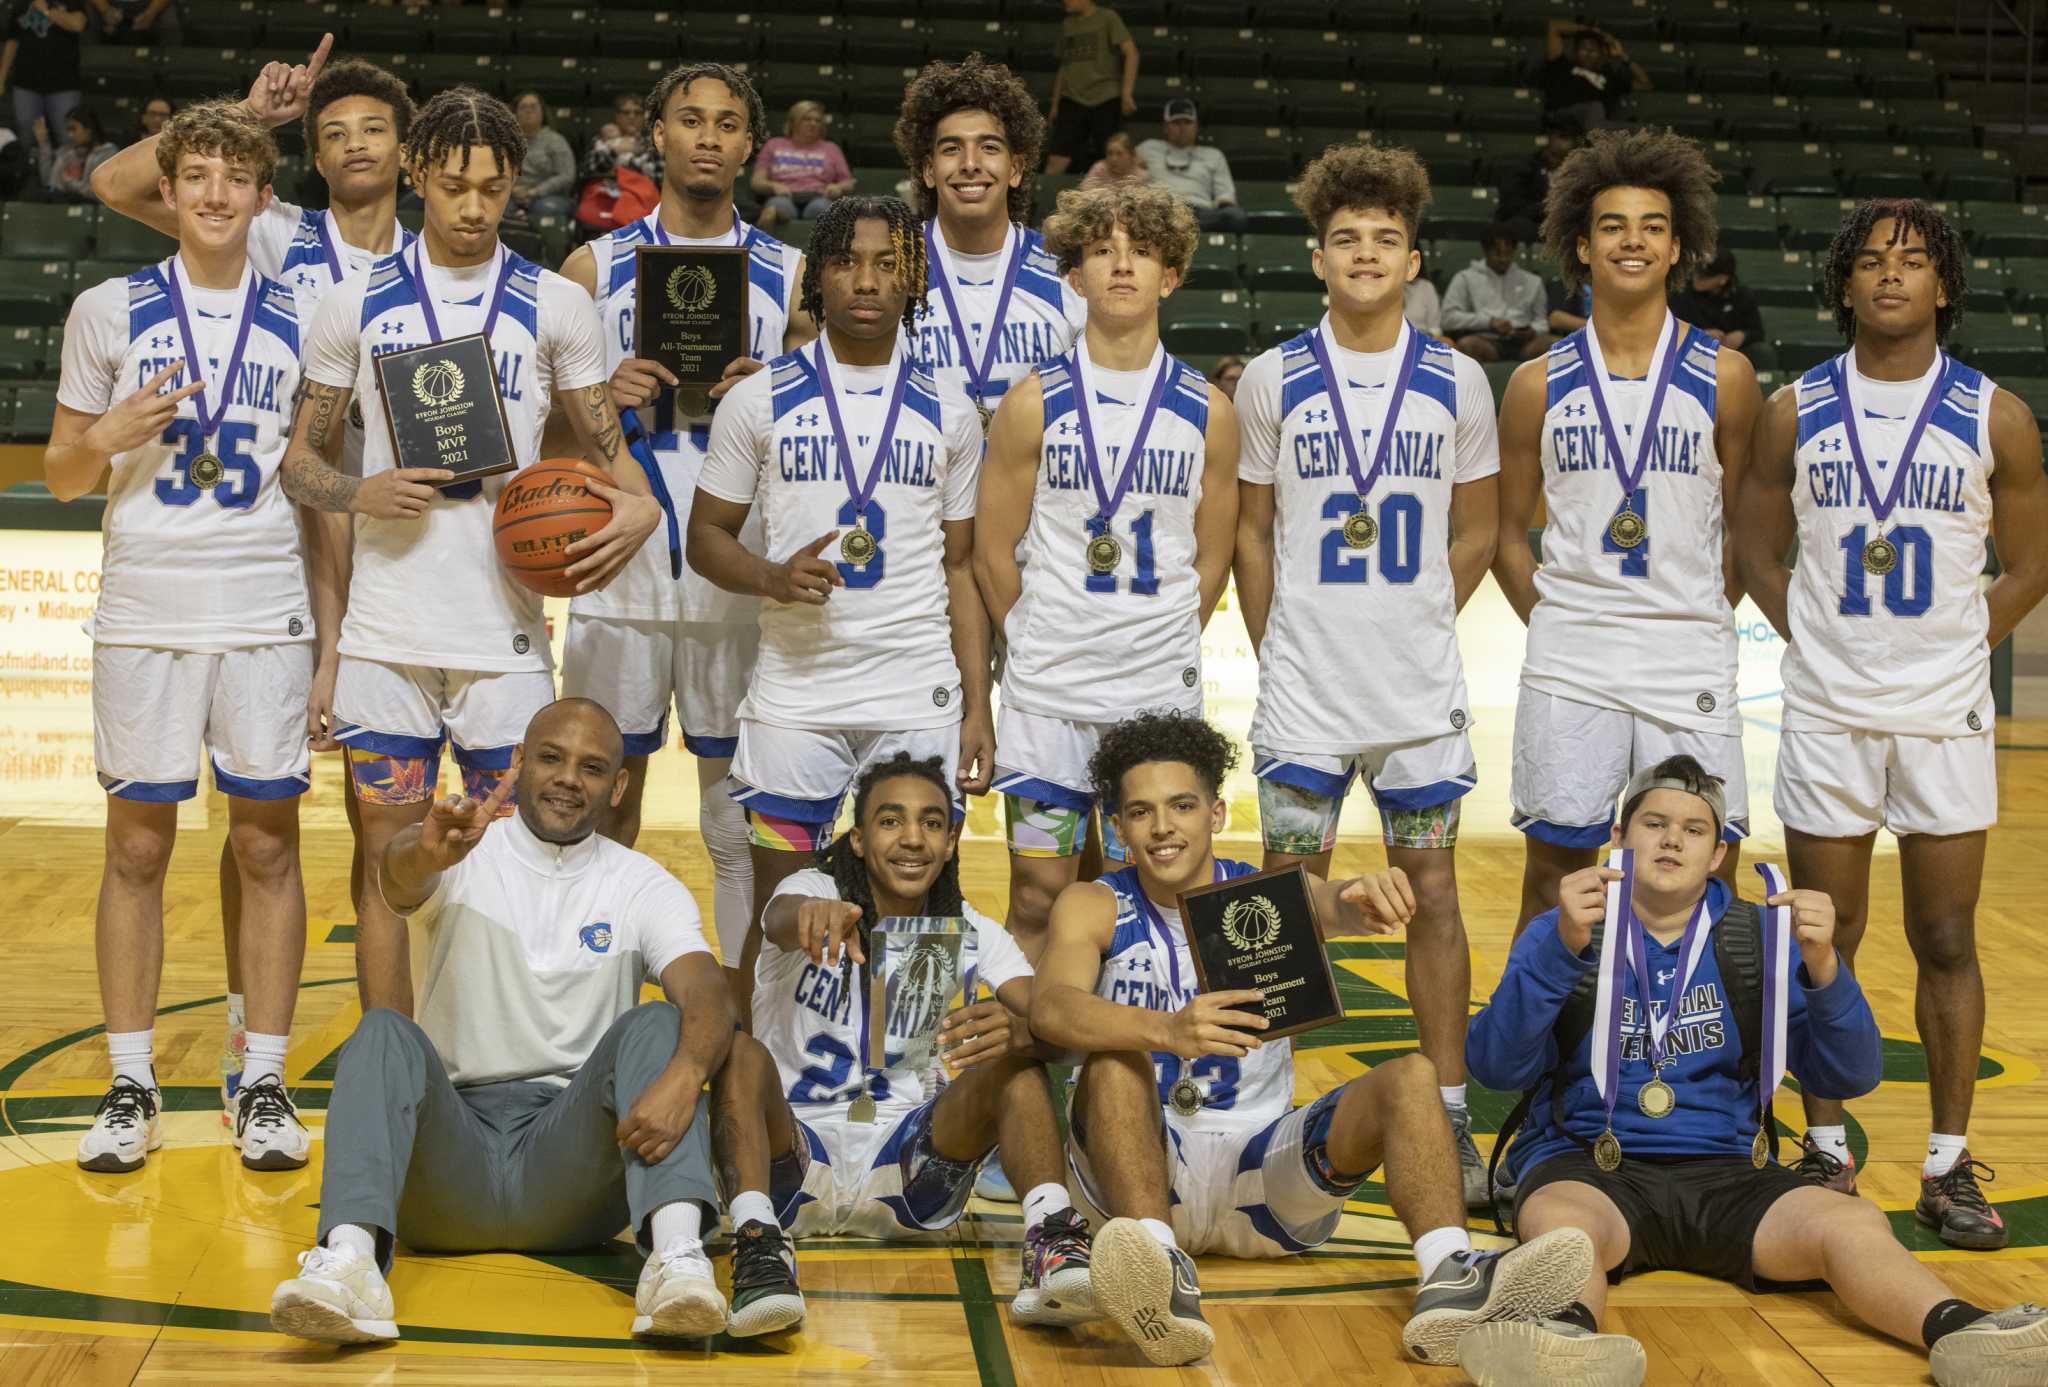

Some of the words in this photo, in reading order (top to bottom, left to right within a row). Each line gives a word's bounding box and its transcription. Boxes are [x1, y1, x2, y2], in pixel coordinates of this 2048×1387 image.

[680, 331, 702, 343] Boys
[680, 353, 702, 361] Team
[680, 363, 700, 373] 2021
[434, 423, 465, 438] Boys
[437, 435, 467, 452] MVP
[153, 416, 262, 510] 35
[441, 449, 469, 466] 2021
[503, 477, 590, 515] Baden
[1318, 490, 1425, 586] 20
[1600, 485, 1651, 580] 4
[834, 497, 889, 591] 3
[1084, 507, 1162, 597] 11
[1838, 522, 1935, 618] 10
[1227, 953, 1253, 967] BYRON
[1255, 943, 1293, 959] JOHNSTON
[1254, 971, 1279, 983] Boys
[1264, 1006, 1288, 1020] 2021
